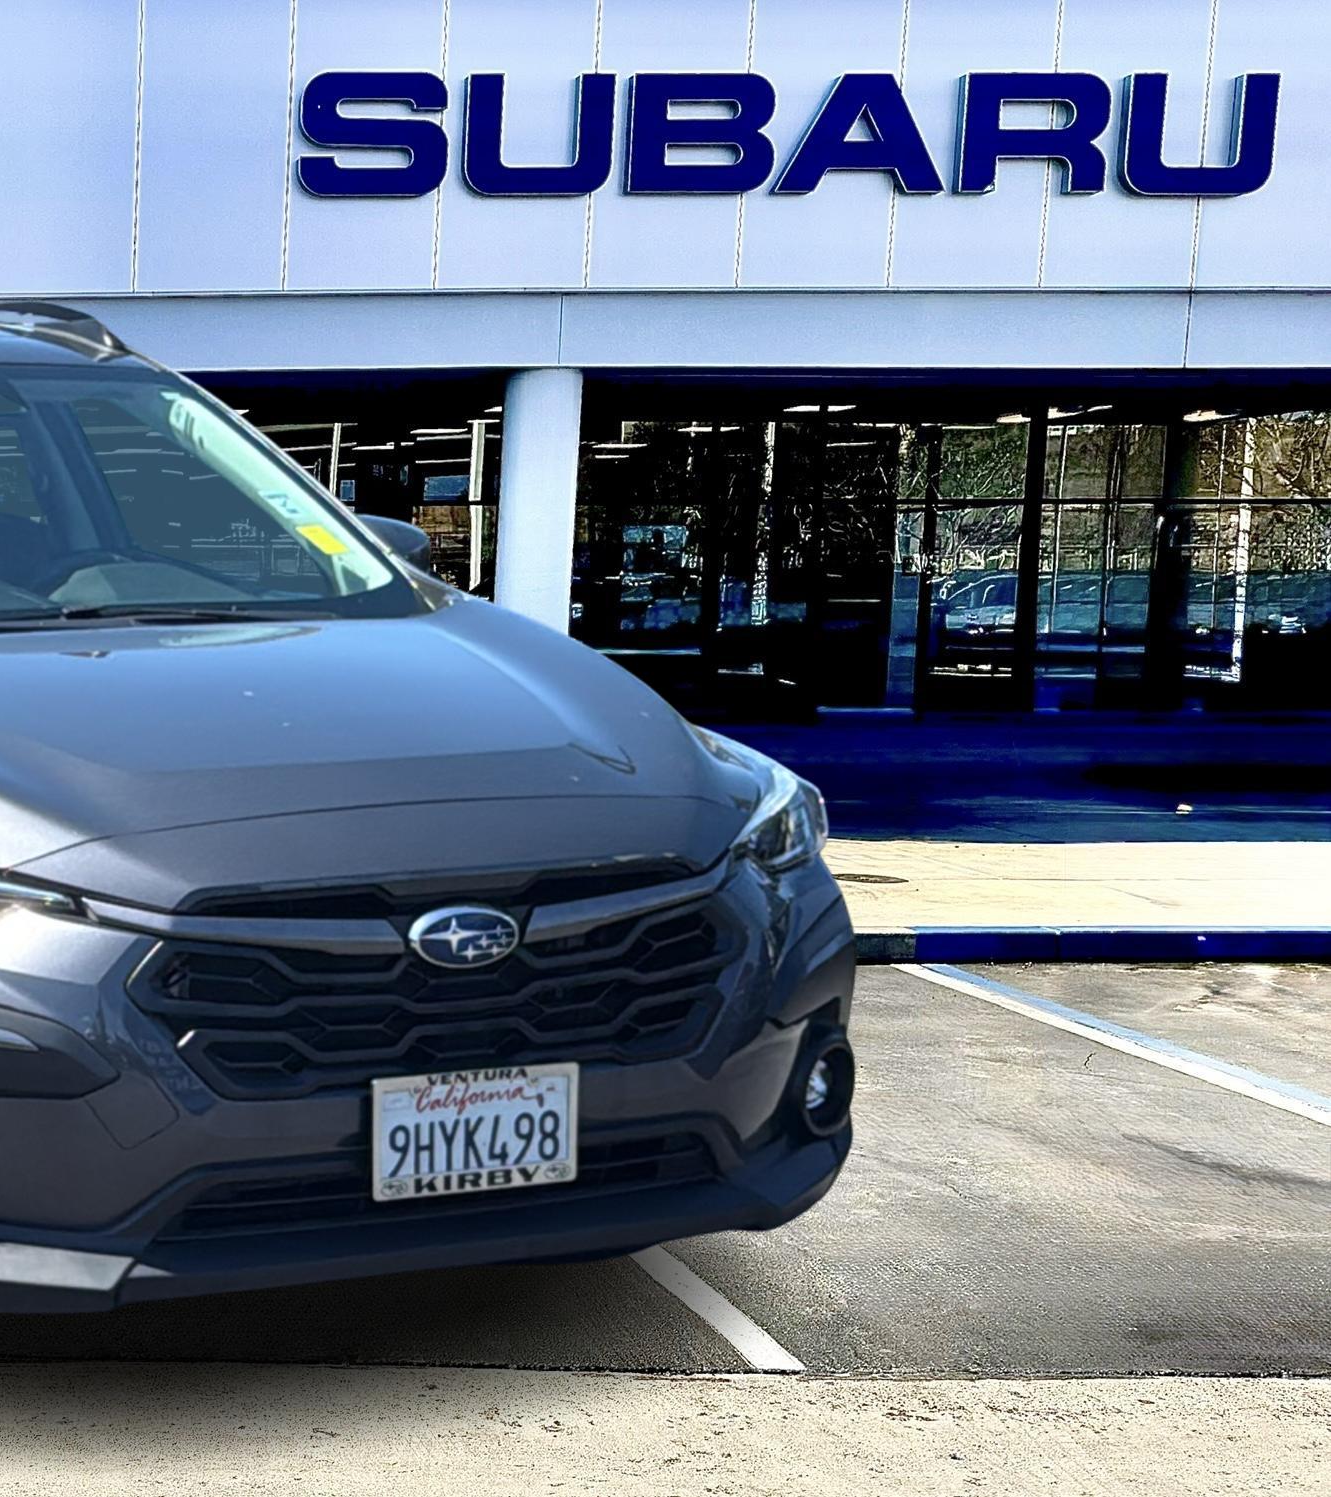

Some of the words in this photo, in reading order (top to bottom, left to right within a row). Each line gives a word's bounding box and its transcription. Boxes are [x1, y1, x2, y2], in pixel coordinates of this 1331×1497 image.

[296, 70, 1281, 196] SUBARU
[426, 1067, 529, 1087] VENTURA
[415, 1084, 530, 1115] California
[388, 1110, 560, 1178] 9HYK498
[413, 1165, 541, 1195] KIRBY
